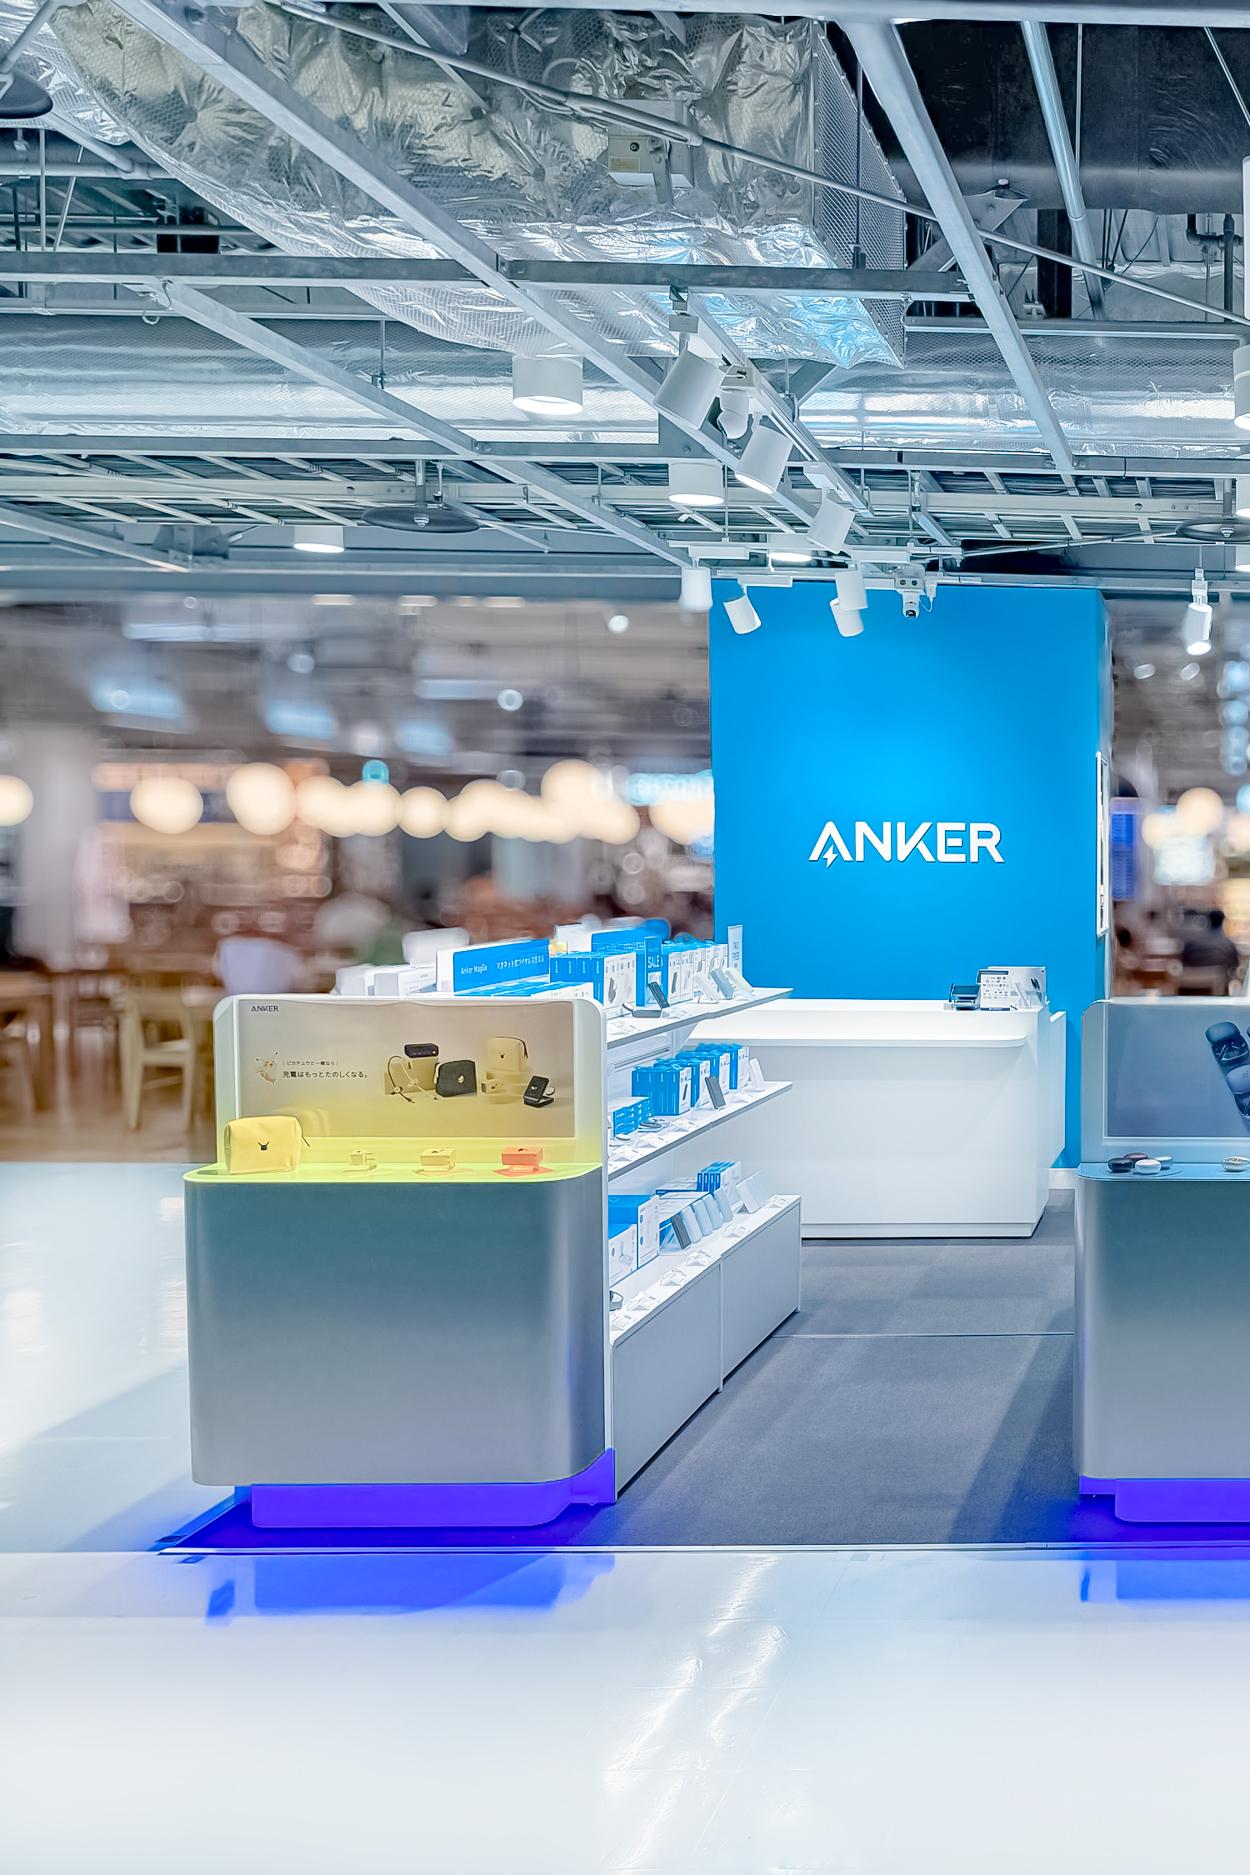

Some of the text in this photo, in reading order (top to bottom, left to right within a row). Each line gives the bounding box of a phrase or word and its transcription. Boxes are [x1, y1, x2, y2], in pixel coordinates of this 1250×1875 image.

[808, 820, 1006, 868] ANKER
[647, 954, 660, 969] SALE
[250, 1005, 280, 1013] ANKER
[282, 1070, 368, 1079] 充電はもっとたのしくなる。
